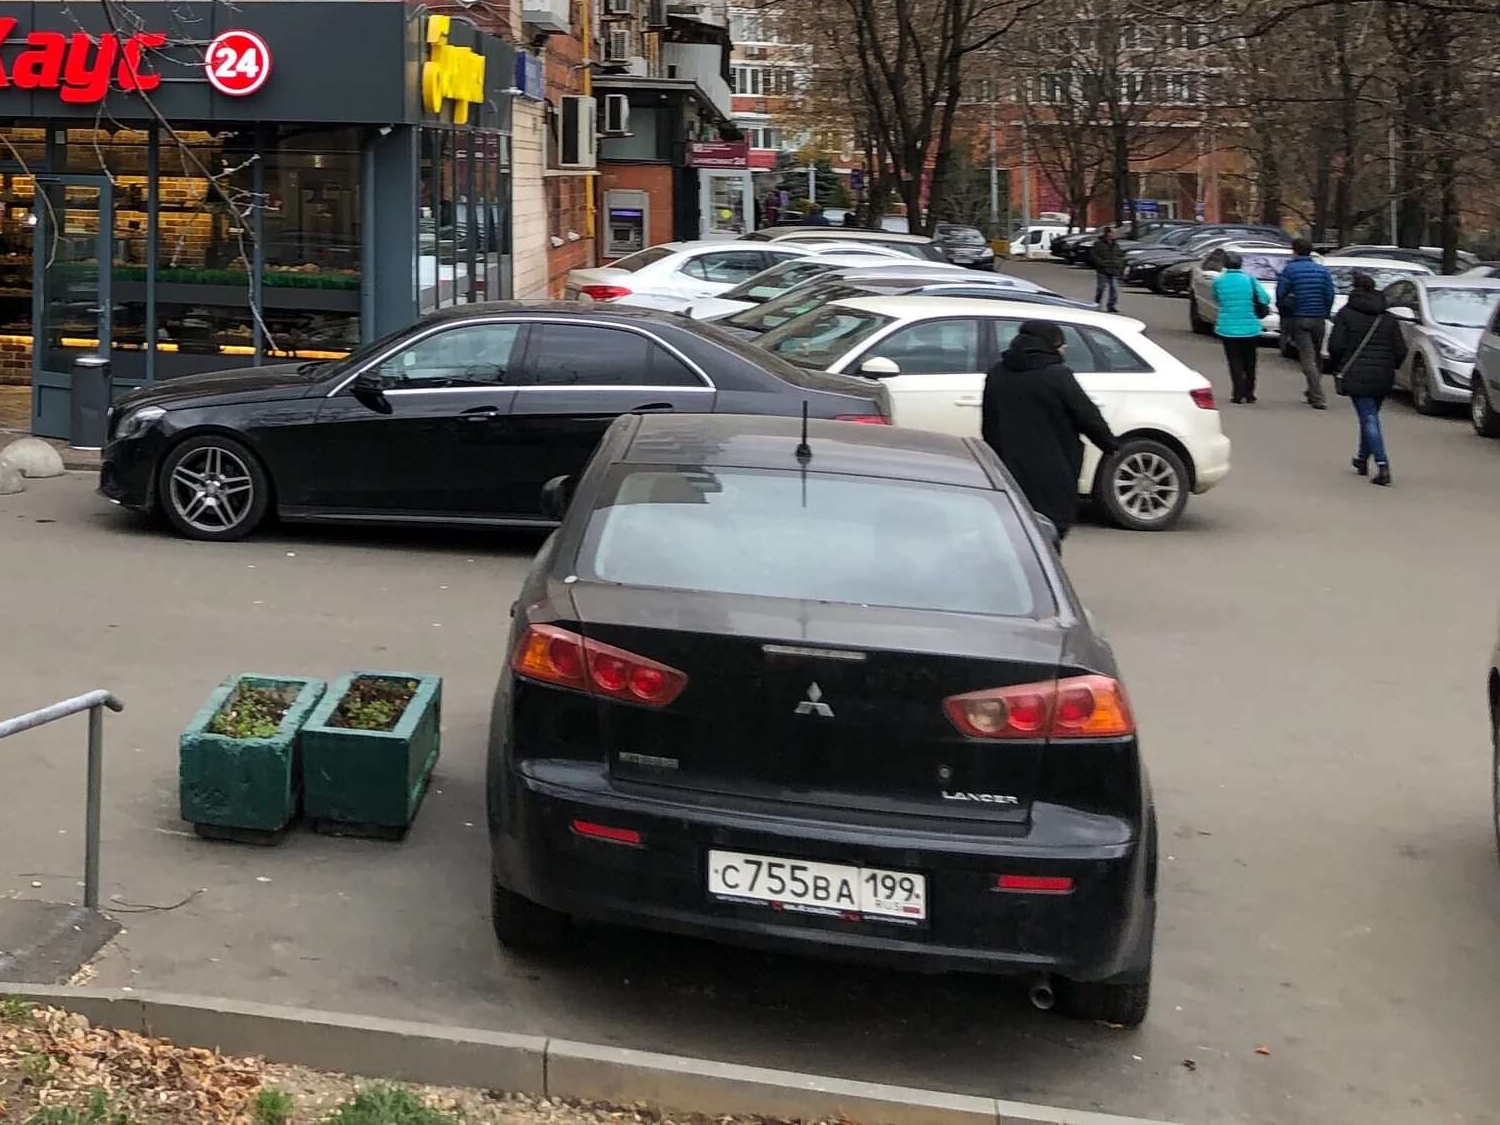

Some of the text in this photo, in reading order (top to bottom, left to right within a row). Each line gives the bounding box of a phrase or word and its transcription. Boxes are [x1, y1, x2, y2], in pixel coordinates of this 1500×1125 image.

[214, 47, 260, 79] 24
[941, 791, 1019, 804] LANCER
[721, 859, 915, 905] С755ВА 199
